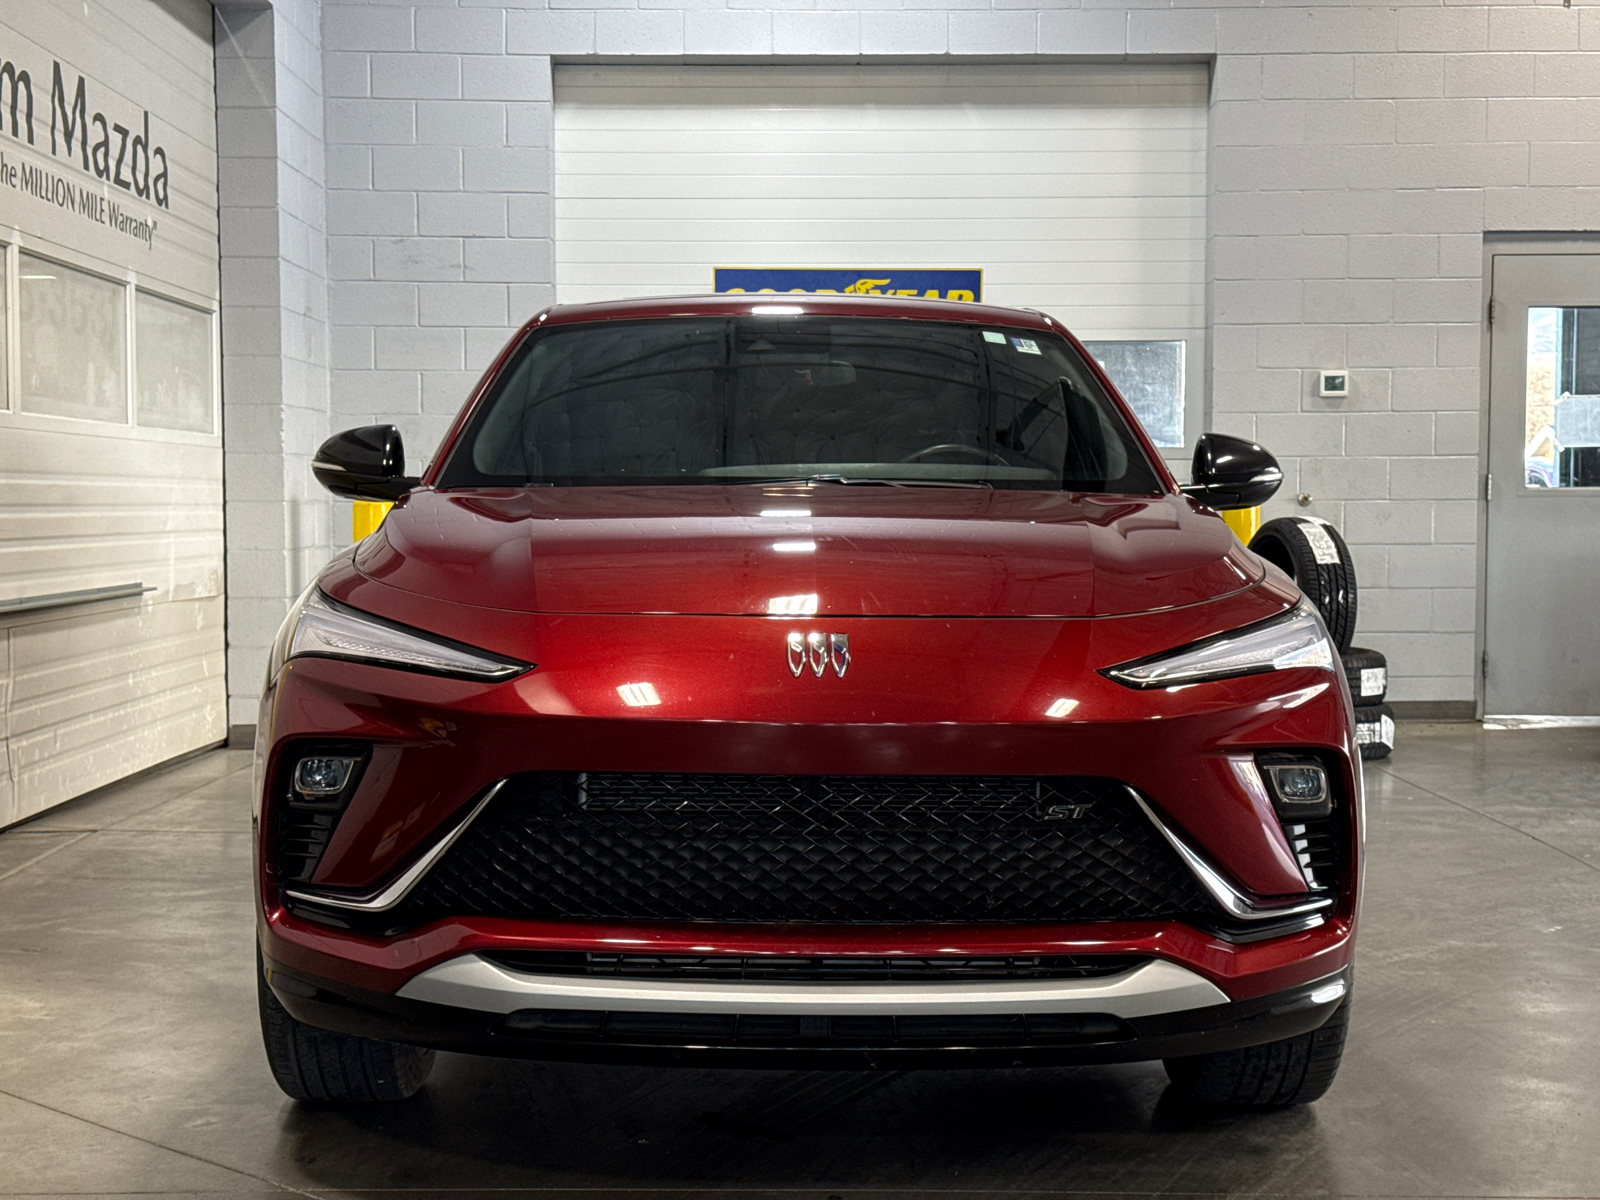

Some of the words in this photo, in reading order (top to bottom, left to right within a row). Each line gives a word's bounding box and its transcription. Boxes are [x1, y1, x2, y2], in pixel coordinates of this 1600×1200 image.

[51, 60, 169, 209] Mazda
[20, 162, 76, 213] MILLION
[78, 188, 106, 225] MILE
[1043, 804, 1093, 821] ST
